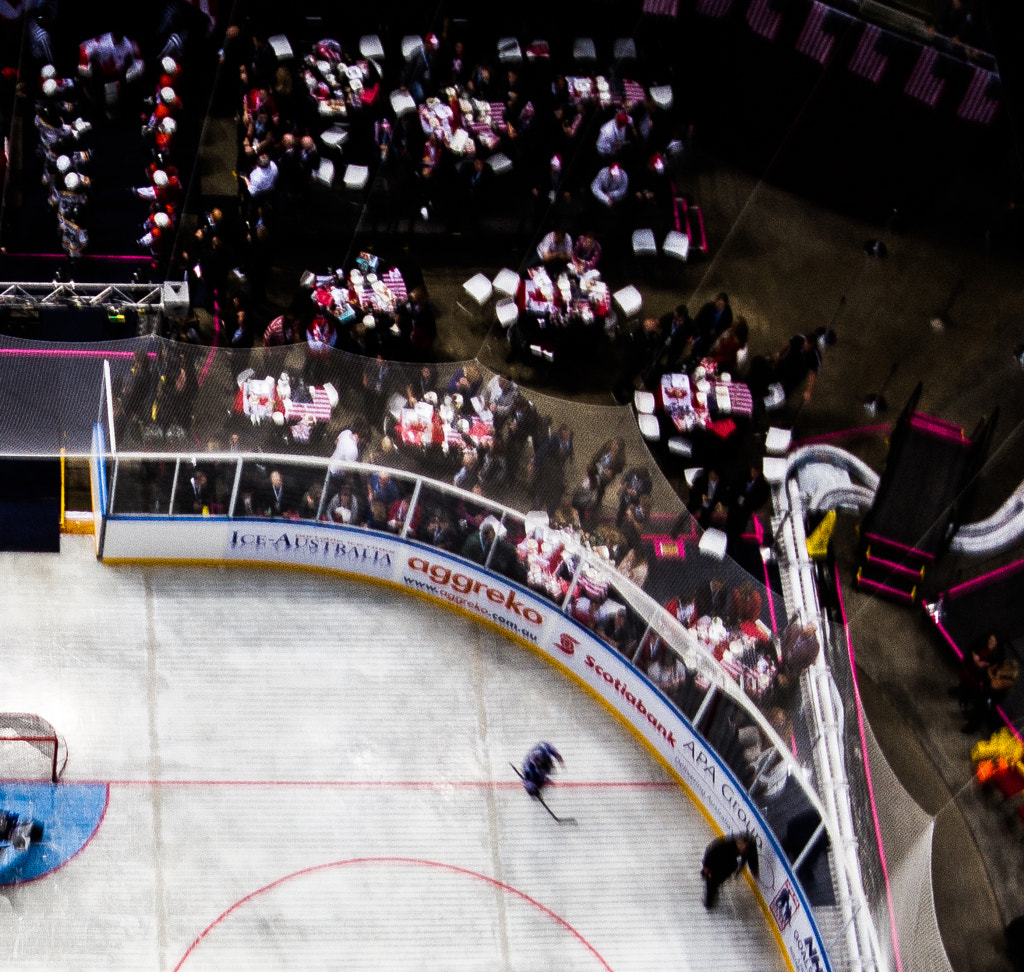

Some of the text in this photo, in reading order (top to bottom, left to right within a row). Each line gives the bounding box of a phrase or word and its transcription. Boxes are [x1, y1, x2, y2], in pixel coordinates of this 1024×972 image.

[402, 575, 538, 641] www.aggreko.com.au
[407, 555, 543, 625] aggreko
[584, 654, 676, 748] Scotiabank
[683, 741, 717, 787] APA
